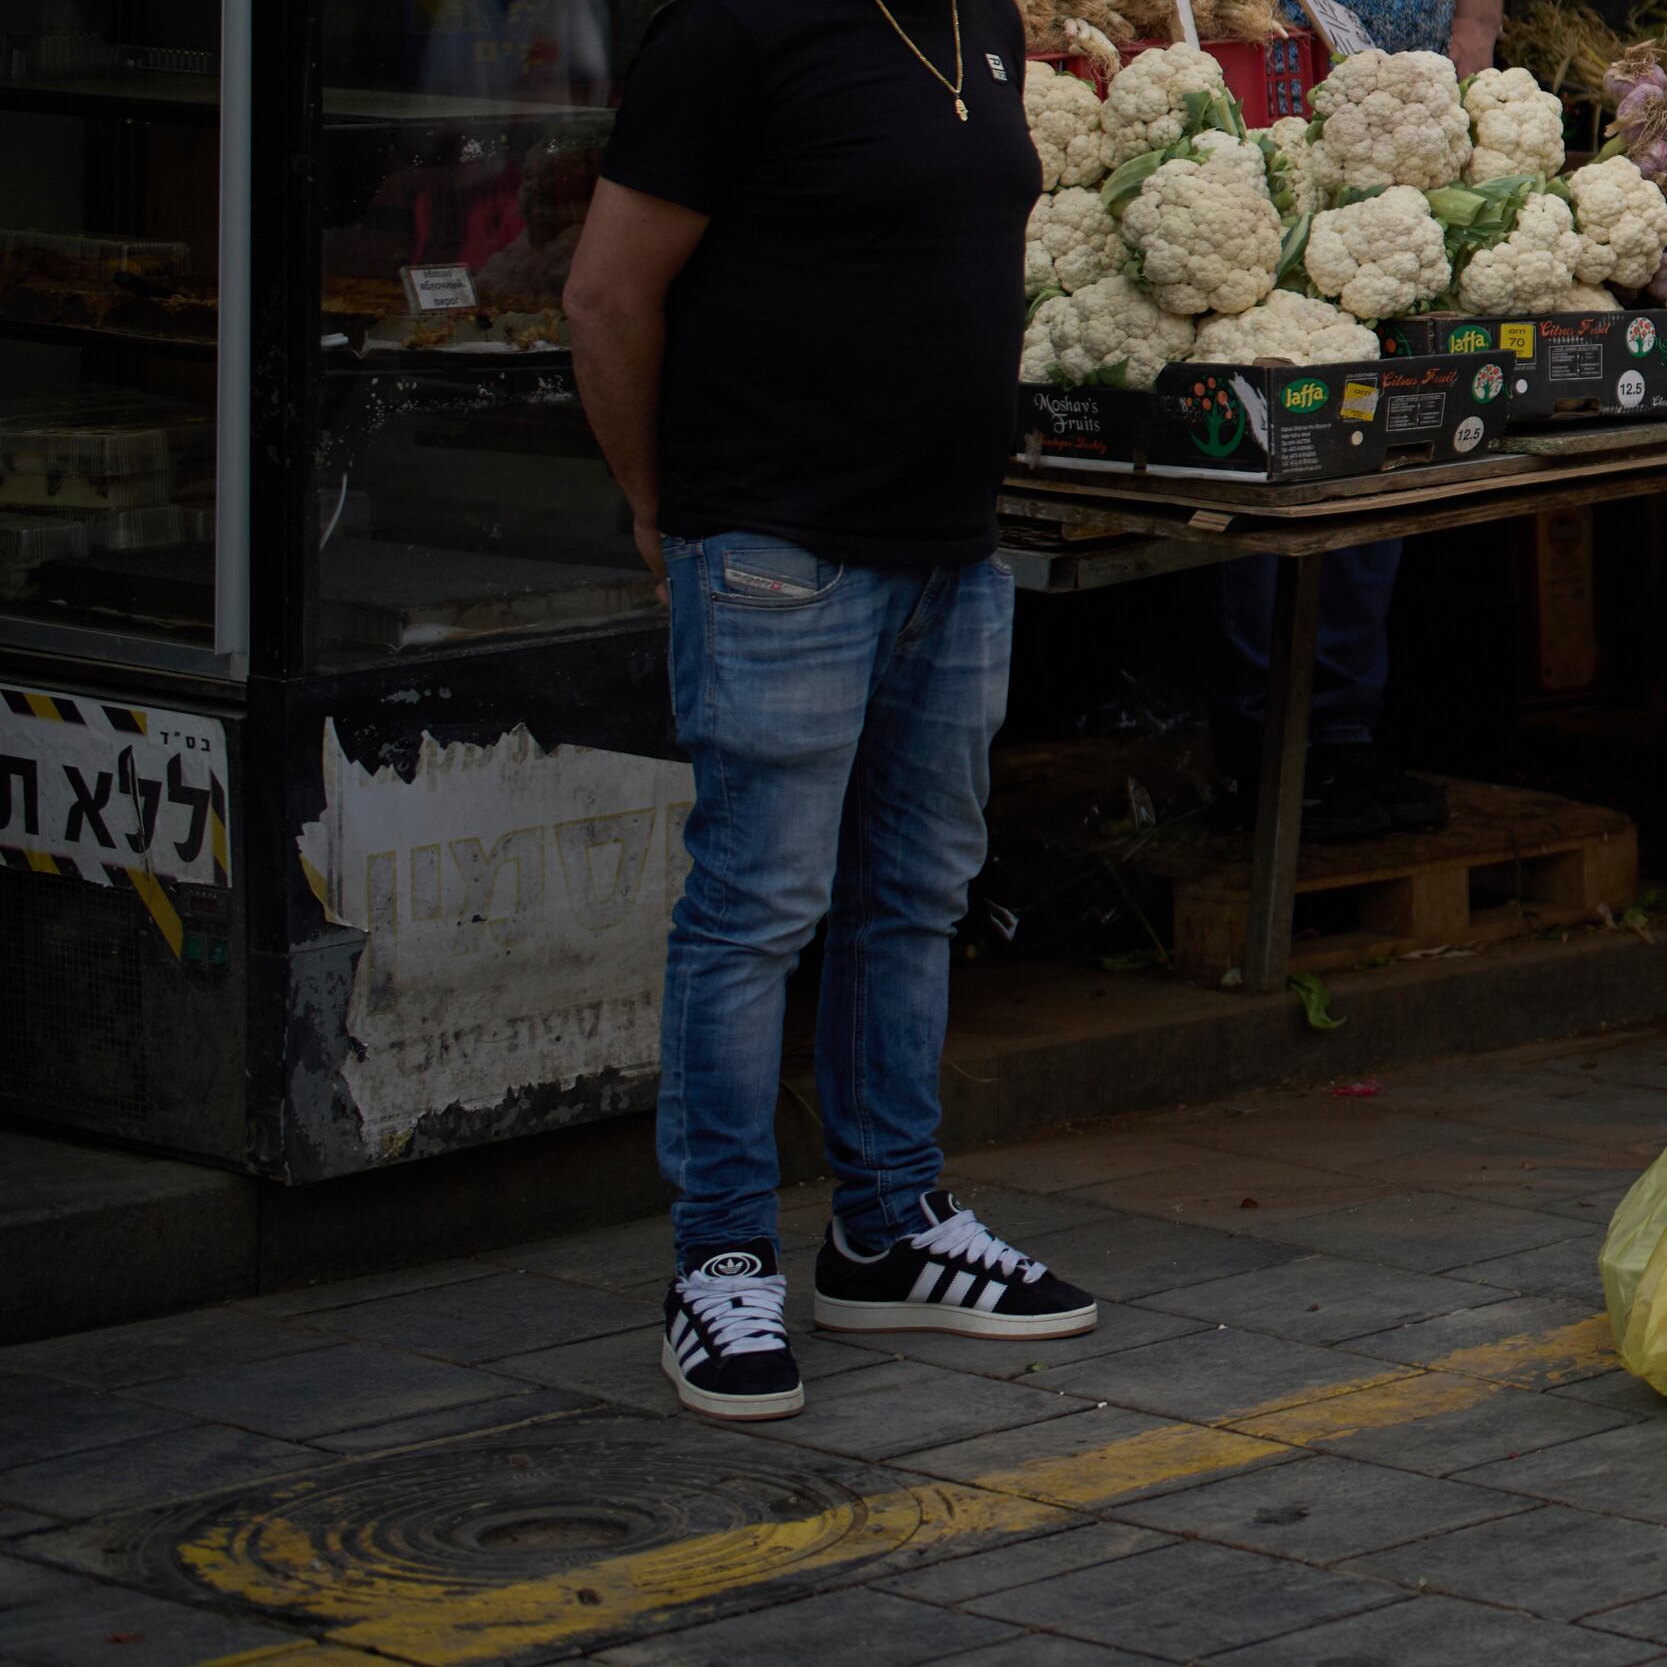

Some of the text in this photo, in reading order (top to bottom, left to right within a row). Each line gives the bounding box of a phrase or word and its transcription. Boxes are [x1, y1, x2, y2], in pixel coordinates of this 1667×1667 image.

[1538, 317, 1612, 338] Citrus Fruit
[1449, 330, 1486, 354] Jaffa
[1508, 336, 1526, 348] 70
[1381, 367, 1459, 389] Citrus Fruit
[1619, 381, 1643, 396] 12.5
[1033, 392, 1100, 415] Moshav's
[1285, 382, 1324, 407] Jaffa
[1051, 411, 1101, 434] Fruits
[1456, 426, 1482, 441] 12.5
[159, 729, 212, 753] בס"ד
[64, 743, 212, 863] ללא
